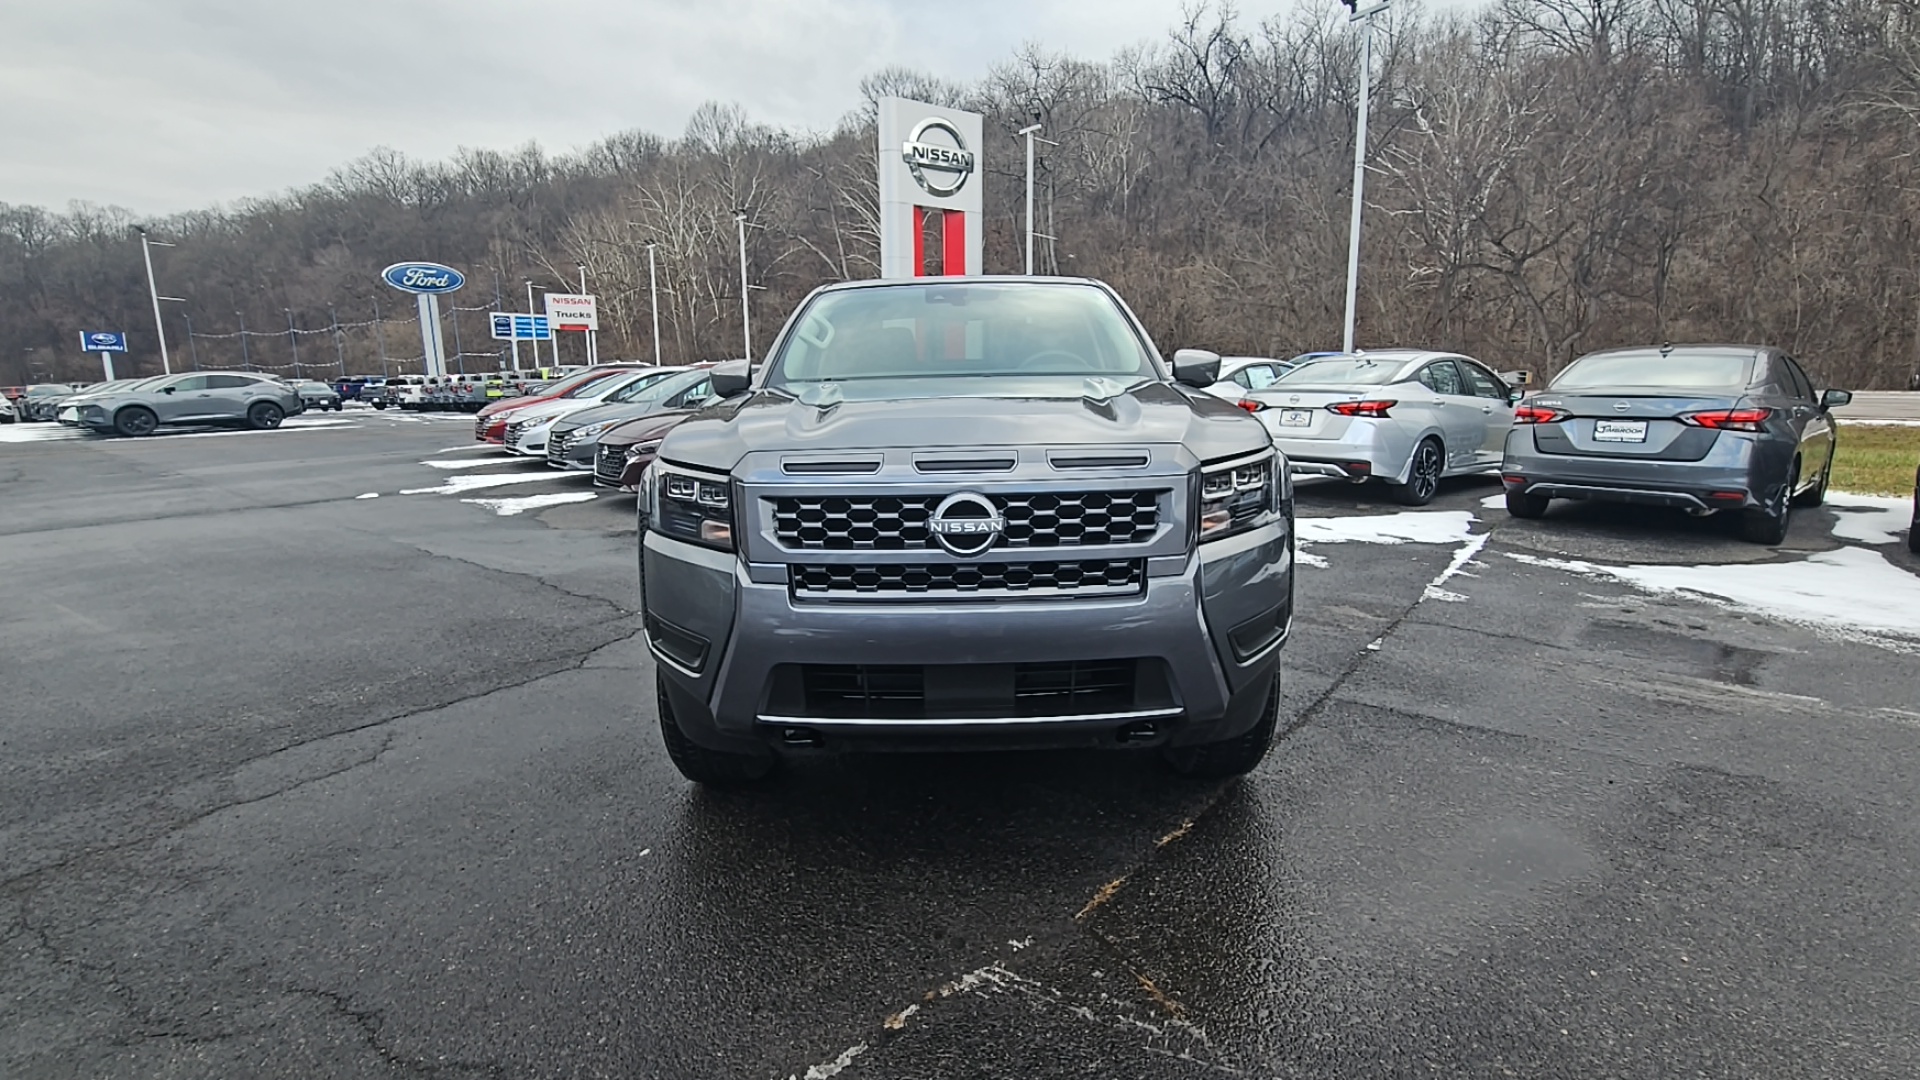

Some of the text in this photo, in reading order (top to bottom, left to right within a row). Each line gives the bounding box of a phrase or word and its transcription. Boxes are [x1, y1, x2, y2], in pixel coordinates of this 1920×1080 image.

[912, 145, 970, 167] NISSAN
[402, 267, 450, 287] Ford
[552, 297, 592, 306] NISSAN
[554, 310, 592, 319] Trucks
[930, 520, 1003, 532] NISSAN
